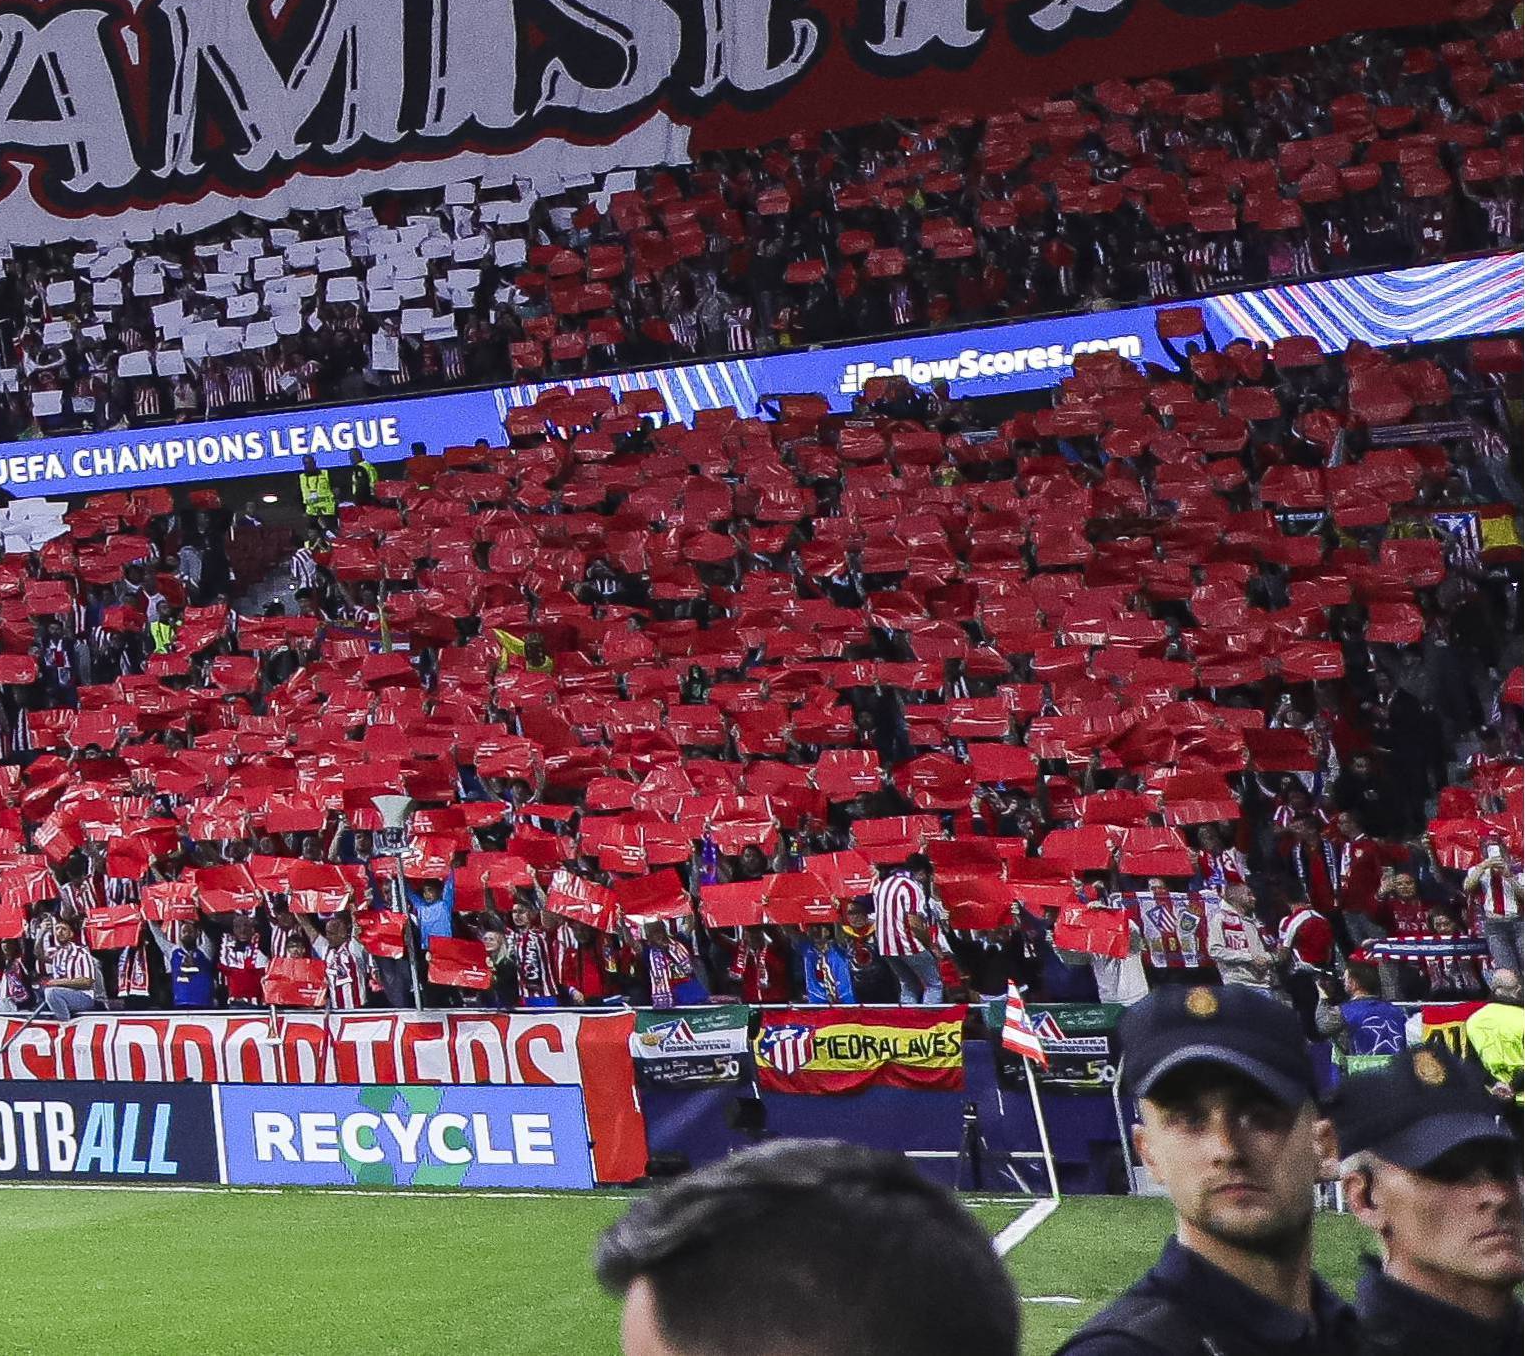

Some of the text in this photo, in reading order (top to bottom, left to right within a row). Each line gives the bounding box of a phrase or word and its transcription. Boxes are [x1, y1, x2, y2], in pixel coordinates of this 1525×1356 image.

[71, 431, 266, 477] CHAMPIONS
[269, 415, 401, 460] LEAGUE
[253, 1109, 558, 1167] RECYCLE
